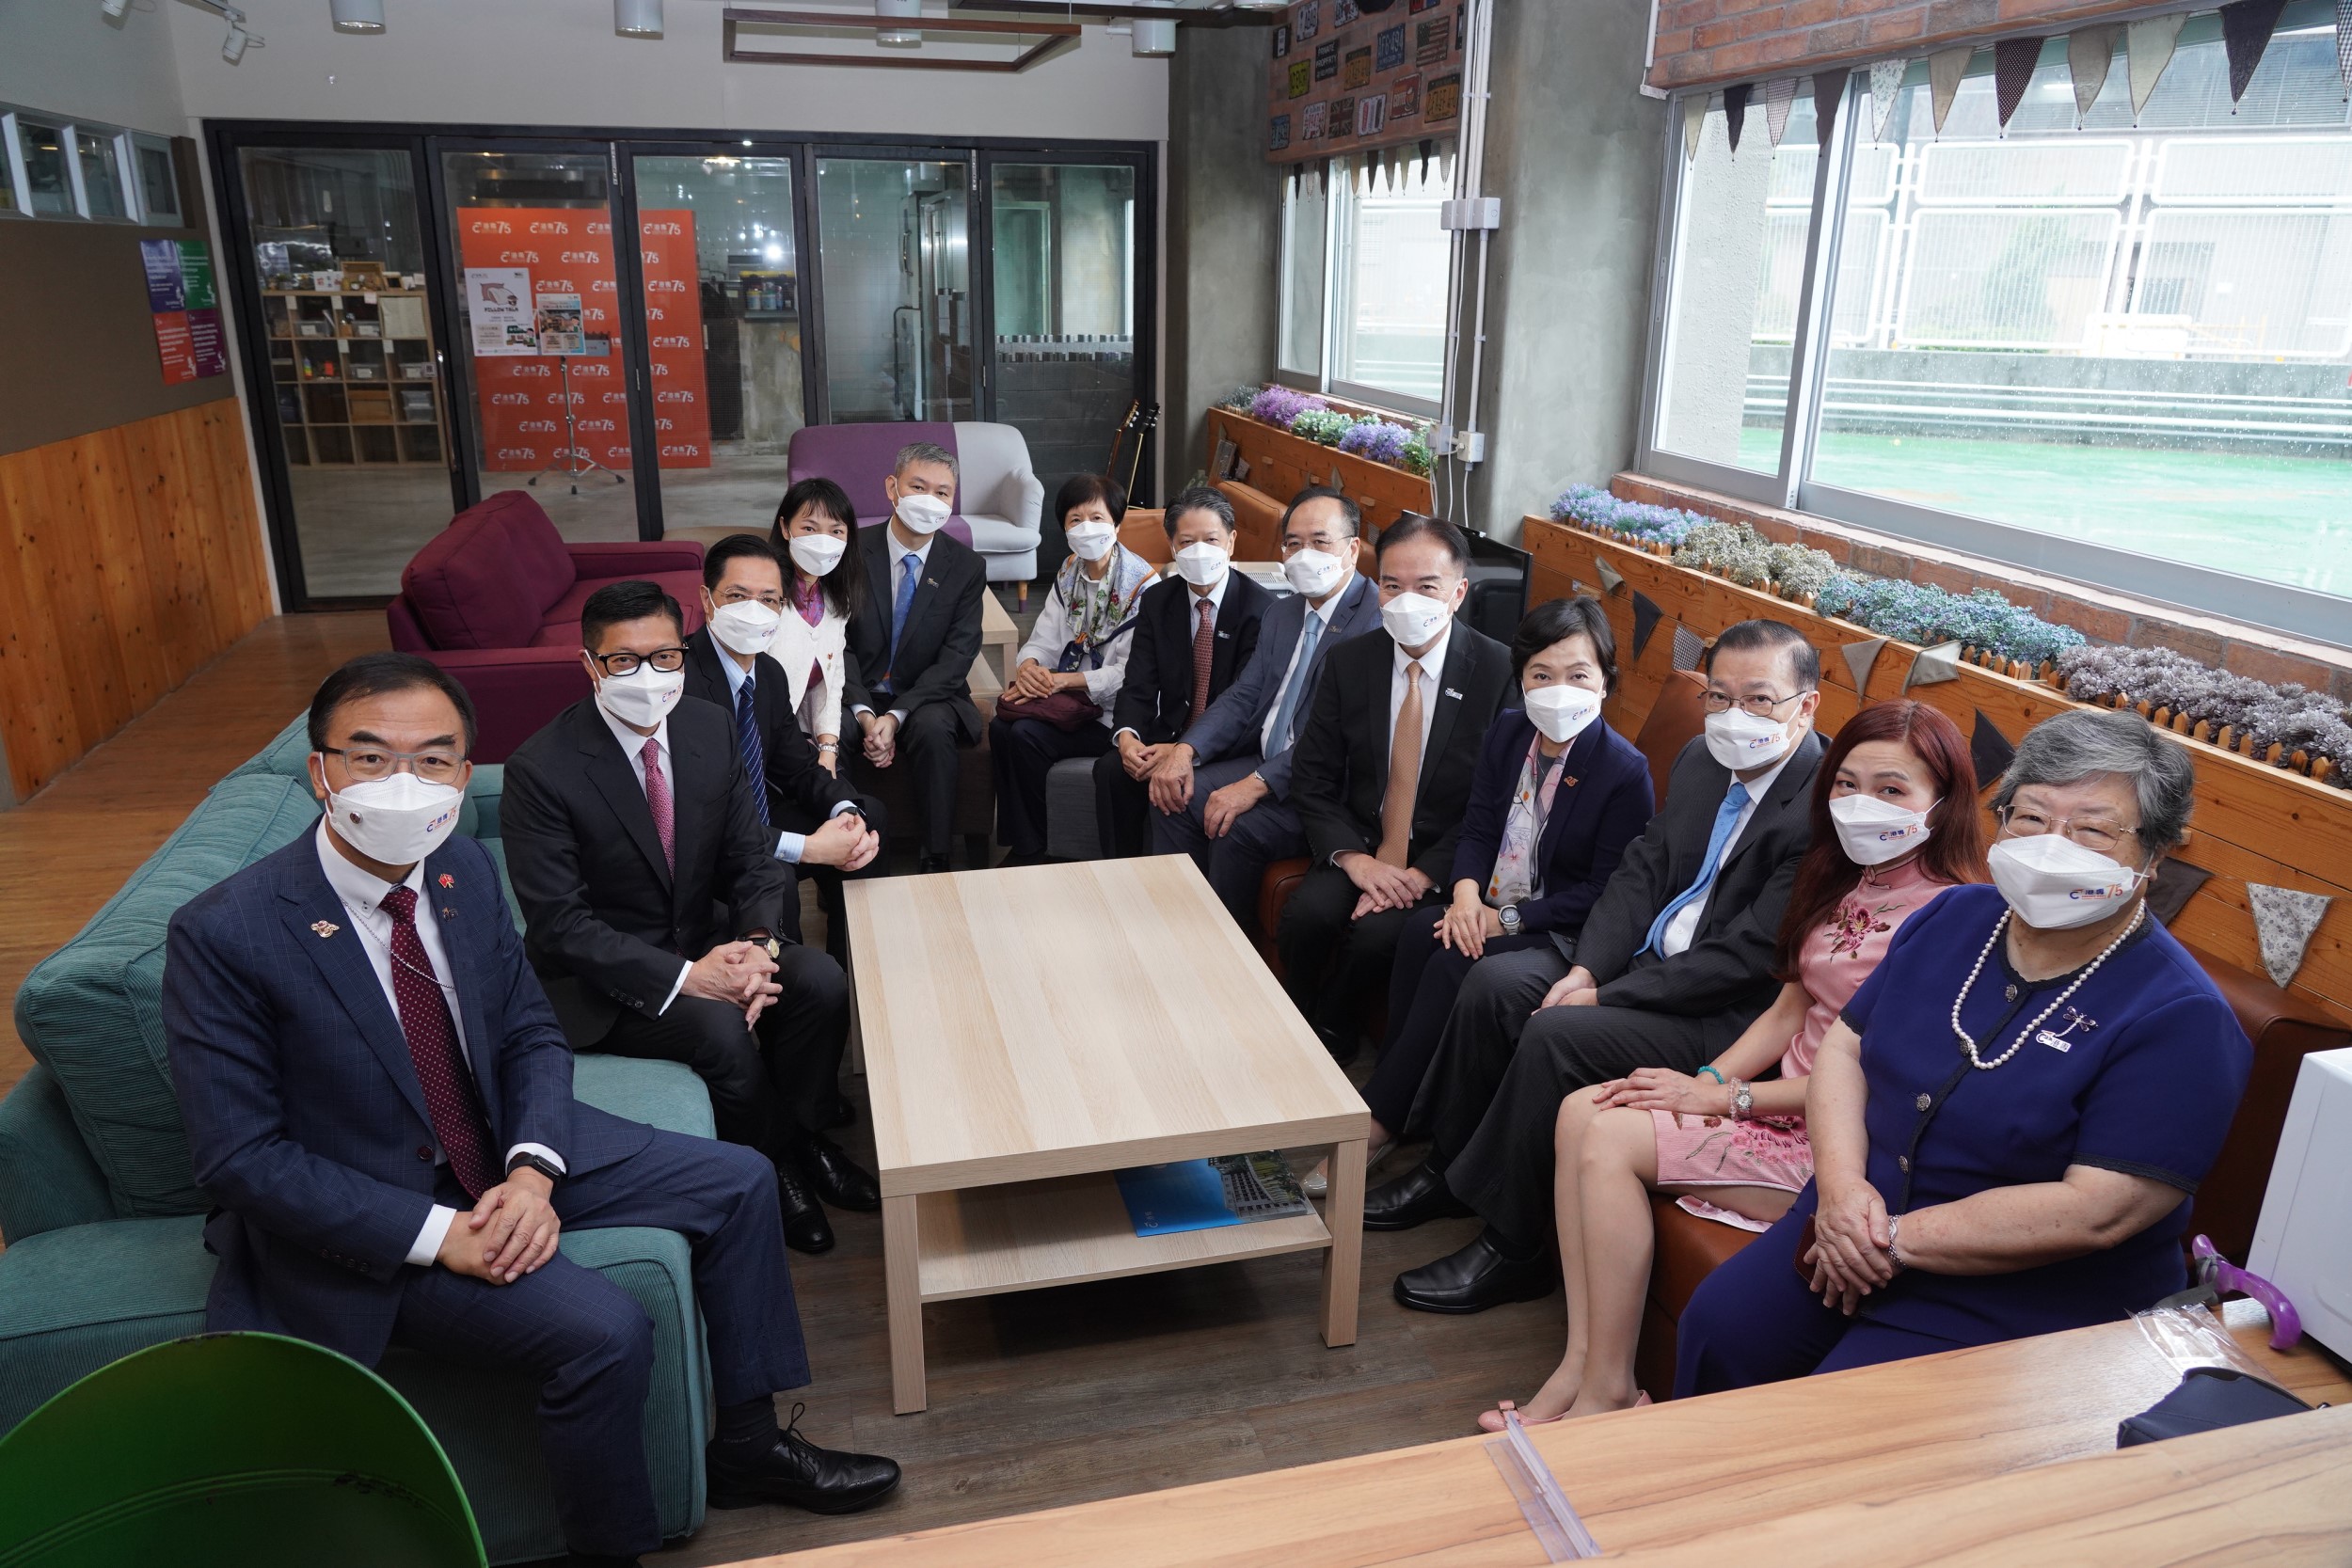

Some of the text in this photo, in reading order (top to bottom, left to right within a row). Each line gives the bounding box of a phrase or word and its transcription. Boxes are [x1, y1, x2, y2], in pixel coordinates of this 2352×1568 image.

[497, 221, 512, 234] 75
[554, 221, 568, 234] 75
[667, 222, 680, 236] 75
[525, 250, 539, 264] 75
[585, 250, 599, 264] 75
[645, 250, 659, 264] 75
[560, 279, 573, 293] 75
[672, 279, 685, 293] 75
[591, 308, 605, 322] 75
[650, 308, 663, 322] 75
[676, 336, 690, 349] 75
[536, 364, 550, 377] 75
[596, 364, 610, 377] 75
[654, 364, 668, 376] 75
[516, 392, 530, 405] 75
[571, 392, 584, 405] 75
[680, 391, 694, 404] 75
[543, 420, 556, 433] 75
[601, 420, 614, 432] 75
[659, 419, 673, 431] 75
[521, 448, 535, 460] 75
[577, 447, 590, 459] 75
[685, 445, 698, 458] 75
[1770, 733, 1780, 744] 75
[1905, 824, 1917, 836] 75
[2106, 883, 2123, 898] 75
